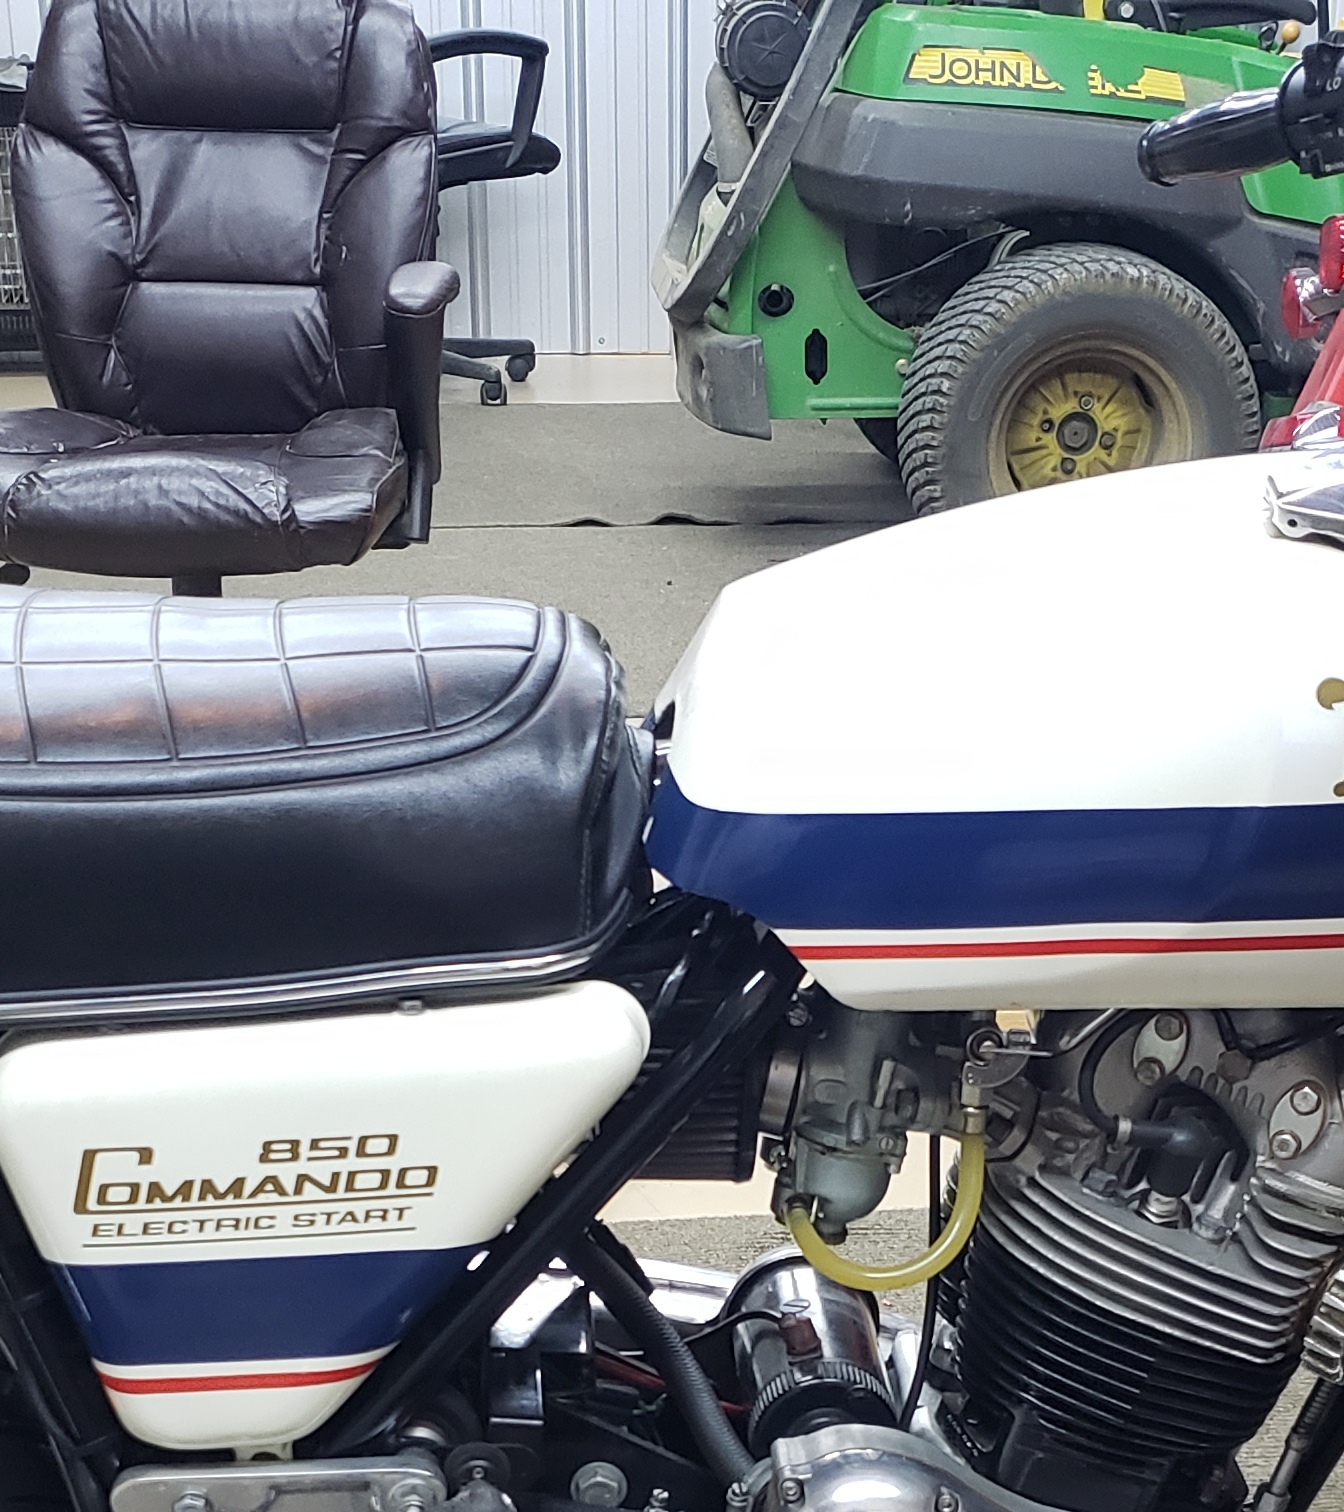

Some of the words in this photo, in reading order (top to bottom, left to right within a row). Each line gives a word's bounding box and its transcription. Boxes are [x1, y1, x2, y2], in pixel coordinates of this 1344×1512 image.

[928, 52, 1021, 82] JOHN
[259, 1134, 399, 1163] 850
[74, 1147, 439, 1215] COMMANDO
[91, 1216, 276, 1239] ELECTRIC
[291, 1207, 414, 1228] START
